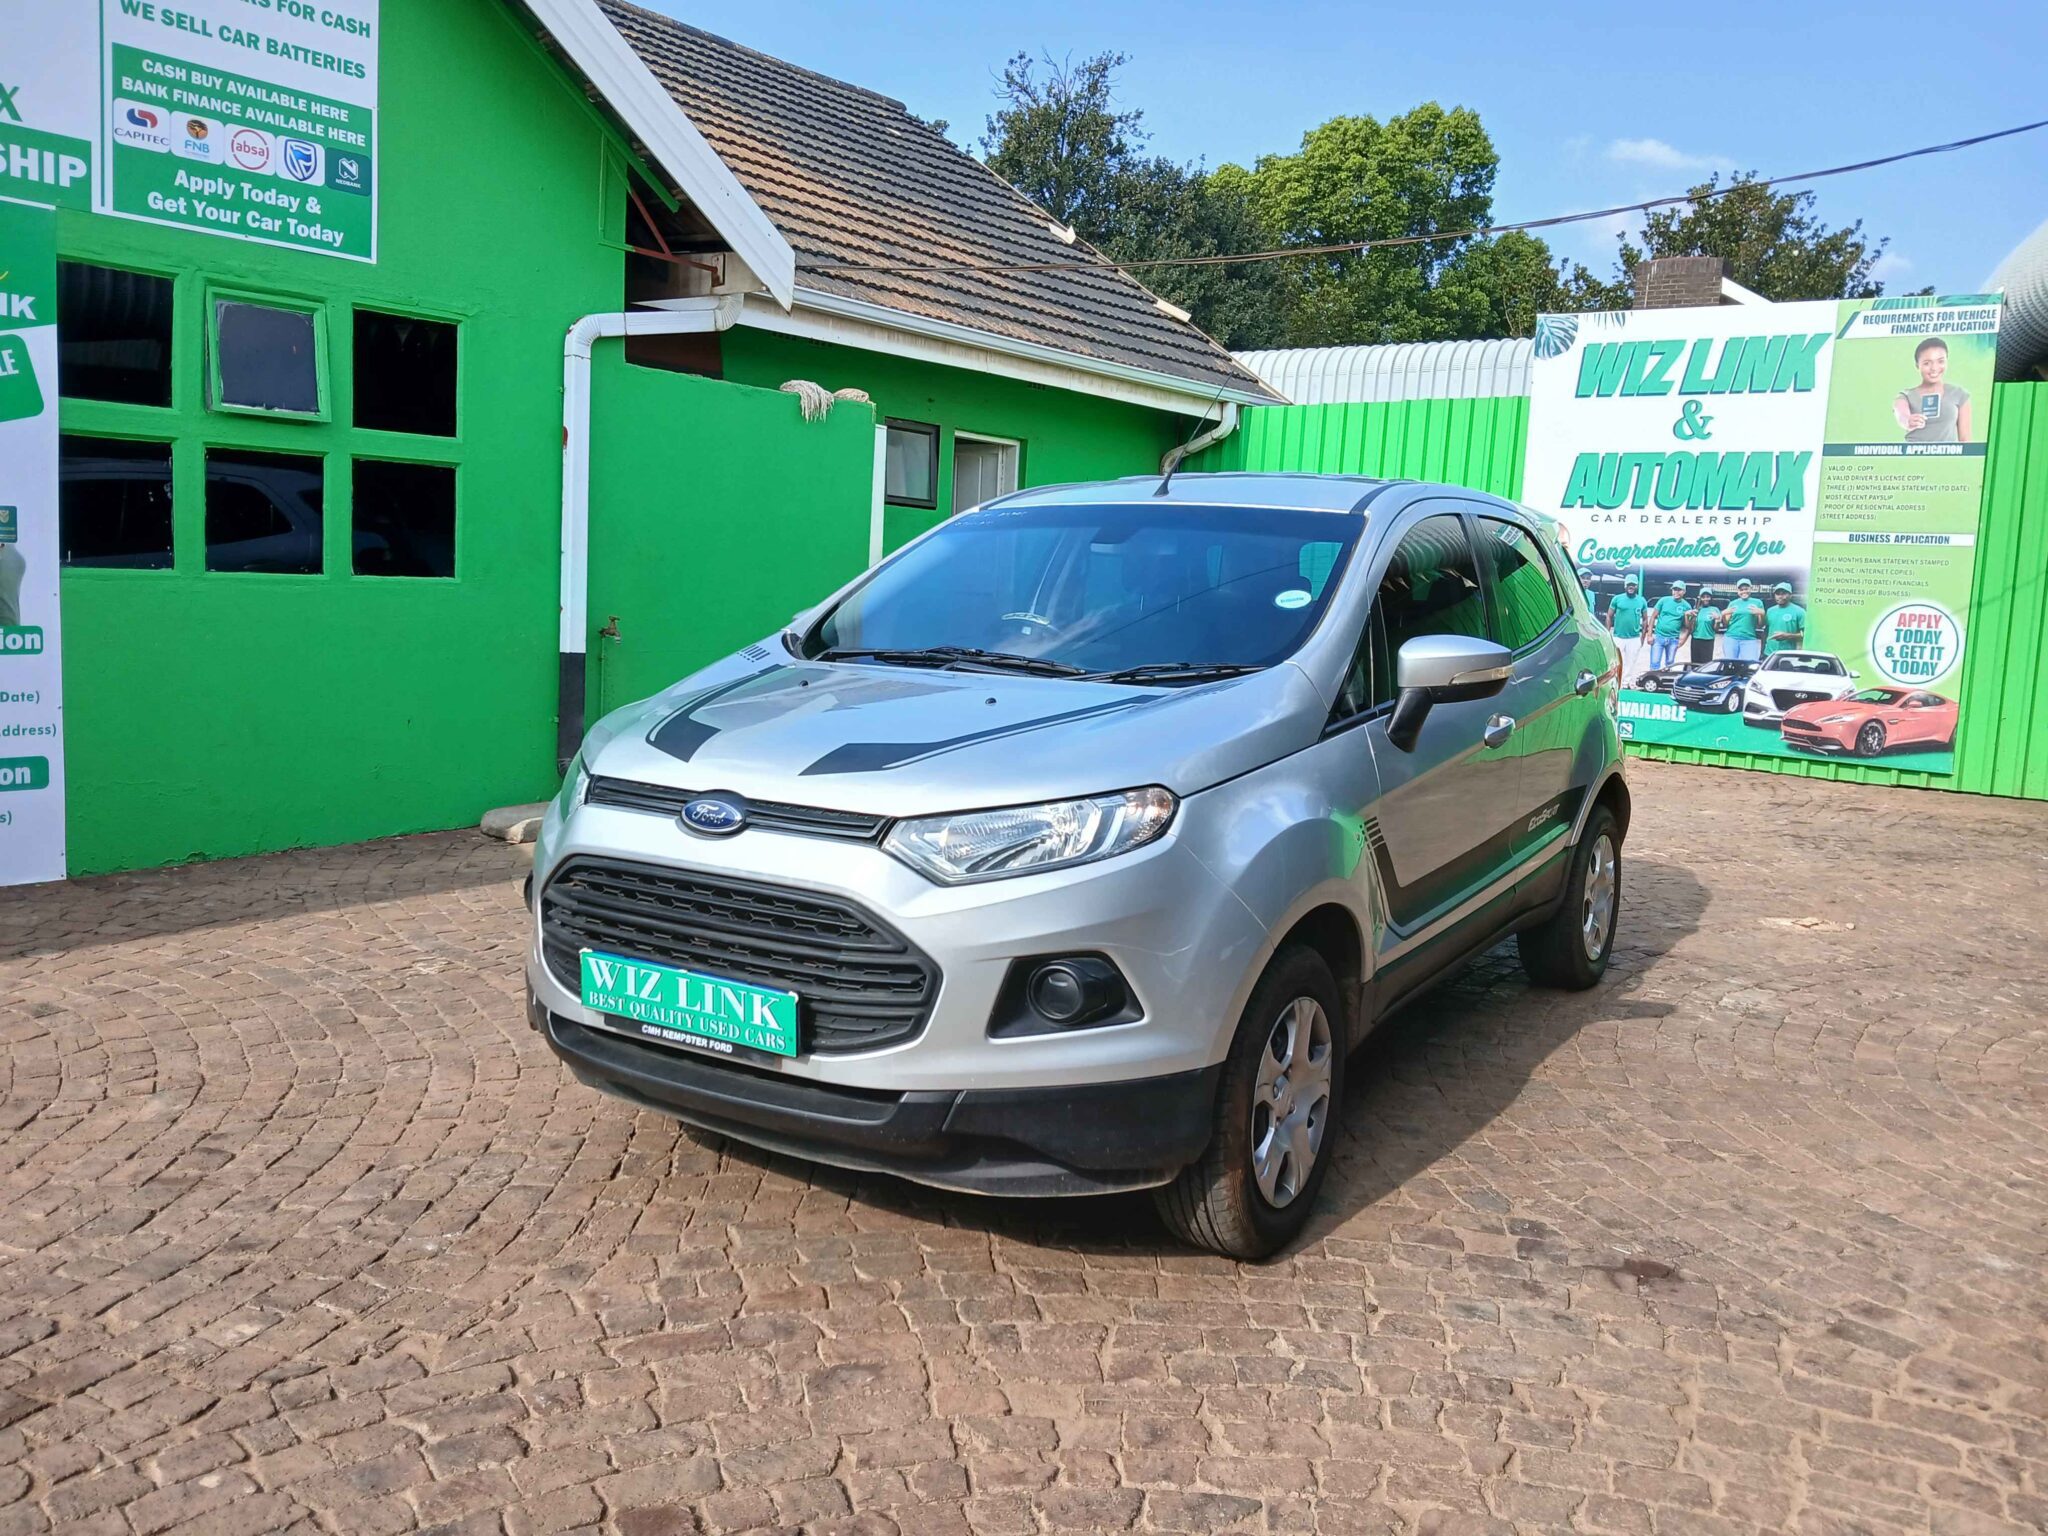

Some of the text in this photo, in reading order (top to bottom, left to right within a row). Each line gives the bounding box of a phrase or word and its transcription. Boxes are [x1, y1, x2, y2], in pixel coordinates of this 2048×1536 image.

[277, 0, 371, 38] FOR CASH
[120, 0, 366, 80] WE SELL CAR BATTERIES
[142, 58, 349, 122] CASH BUY AVAILABLE HERE
[121, 76, 366, 148] BANK FINANCE AVAILABLE HERE
[114, 128, 170, 146] CAPITEC
[184, 140, 210, 153] FNB
[235, 140, 266, 156] absa
[174, 169, 322, 215] Apply Today &
[147, 191, 344, 248] Get Your Car Today
[1863, 309, 1997, 325] REQUIREMENTS FOR VEHICLE
[1891, 320, 1996, 334] FINANCE APPLICATION
[1575, 332, 1833, 398] WIZ LINK
[1672, 399, 1714, 440] &
[1854, 445, 1963, 454] INDIVIDUAL APPLICATION
[1560, 451, 1814, 511] AUTOMAX
[1590, 514, 1772, 526] CAR DEALERSHIP
[1848, 534, 1950, 544] BUSINESS APPLICATION
[1577, 531, 1786, 568] Congratulates You
[1896, 612, 1942, 629] APPLY
[1894, 628, 1942, 645] TODAY
[1884, 644, 1945, 660] & GET IT
[1891, 659, 1938, 676] TODAY
[0, 723, 56, 738] ddress)
[692, 804, 726, 824] Ford
[586, 956, 784, 1031] WIZ LINK
[589, 991, 786, 1051] BEST QUALITY USED CARS
[642, 1024, 733, 1054] CMH KEMPSTER FORD
